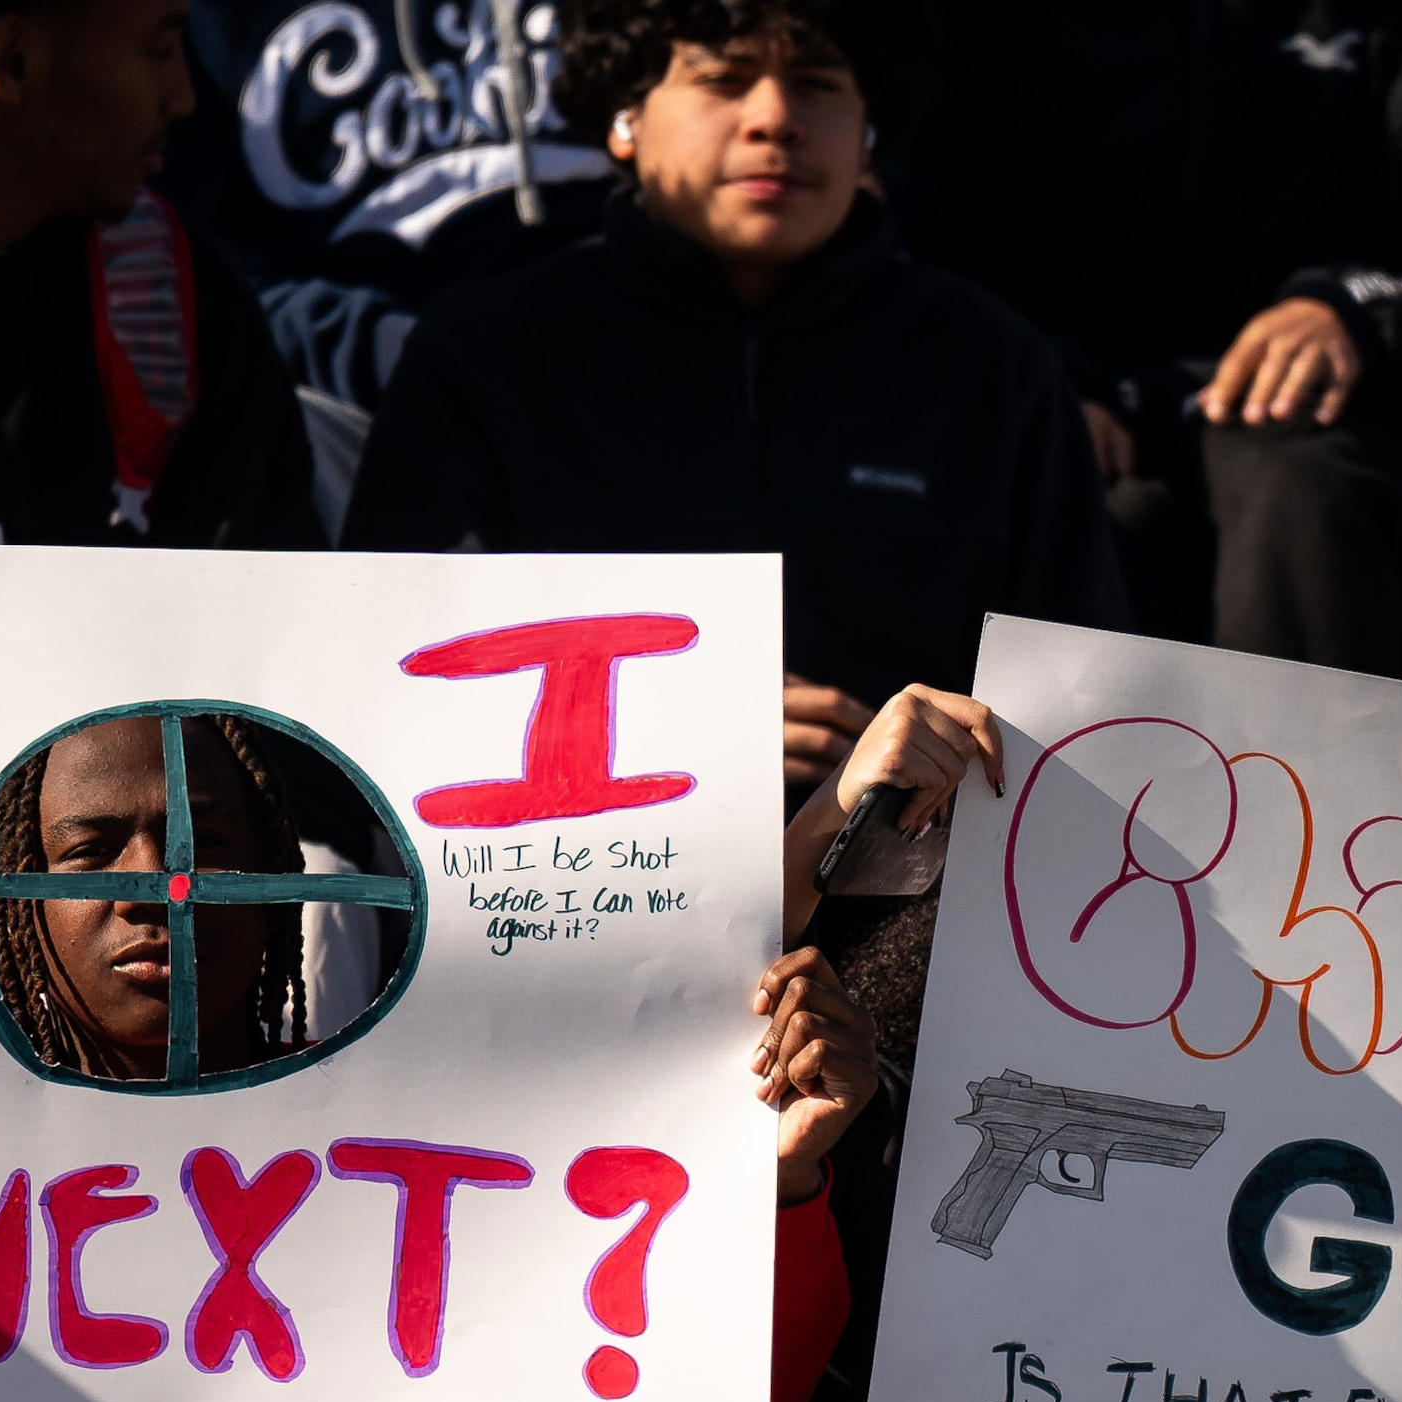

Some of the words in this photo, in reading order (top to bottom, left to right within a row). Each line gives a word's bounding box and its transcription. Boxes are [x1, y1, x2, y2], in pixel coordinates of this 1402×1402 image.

[398, 611, 700, 829] I
[442, 839, 493, 878] Will
[502, 844, 536, 871] I
[553, 836, 594, 871] be
[469, 882, 549, 915] before
[554, 889, 582, 914] I
[486, 916, 558, 956] against
[564, 917, 600, 940] it?
